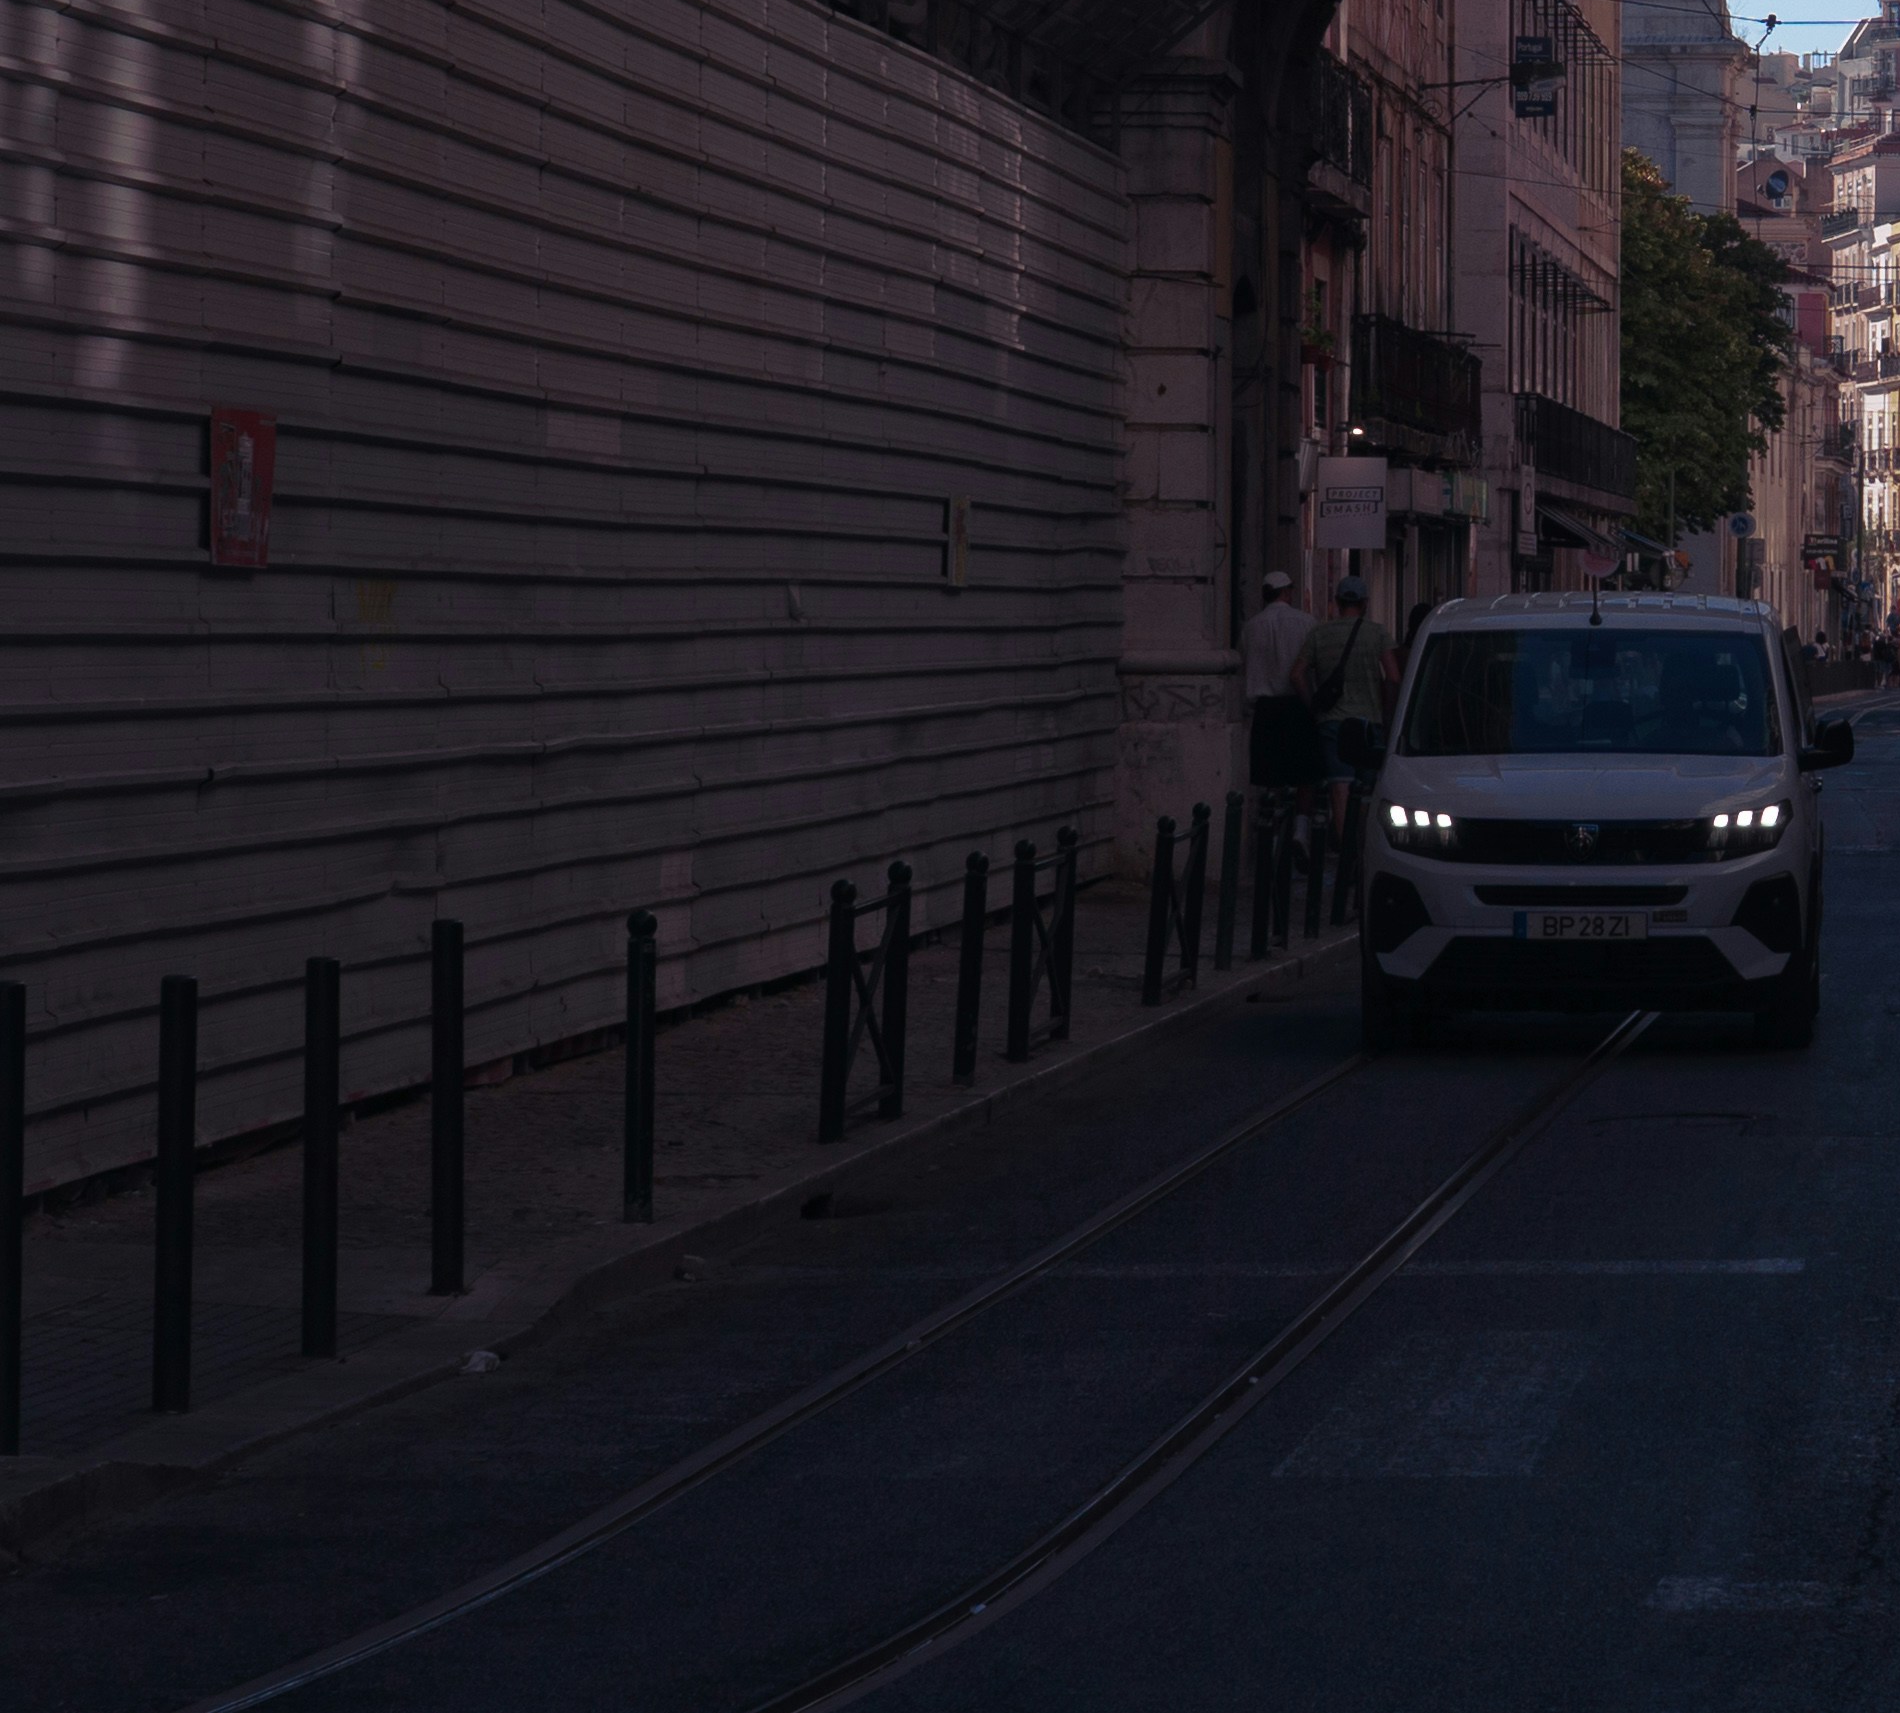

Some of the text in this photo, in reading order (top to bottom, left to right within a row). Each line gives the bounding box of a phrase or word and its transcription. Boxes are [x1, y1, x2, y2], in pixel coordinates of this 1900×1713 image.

[1331, 490, 1378, 499] PROJECT
[1325, 502, 1371, 514] SMASH
[1543, 916, 1629, 937] BP 28 ZI
